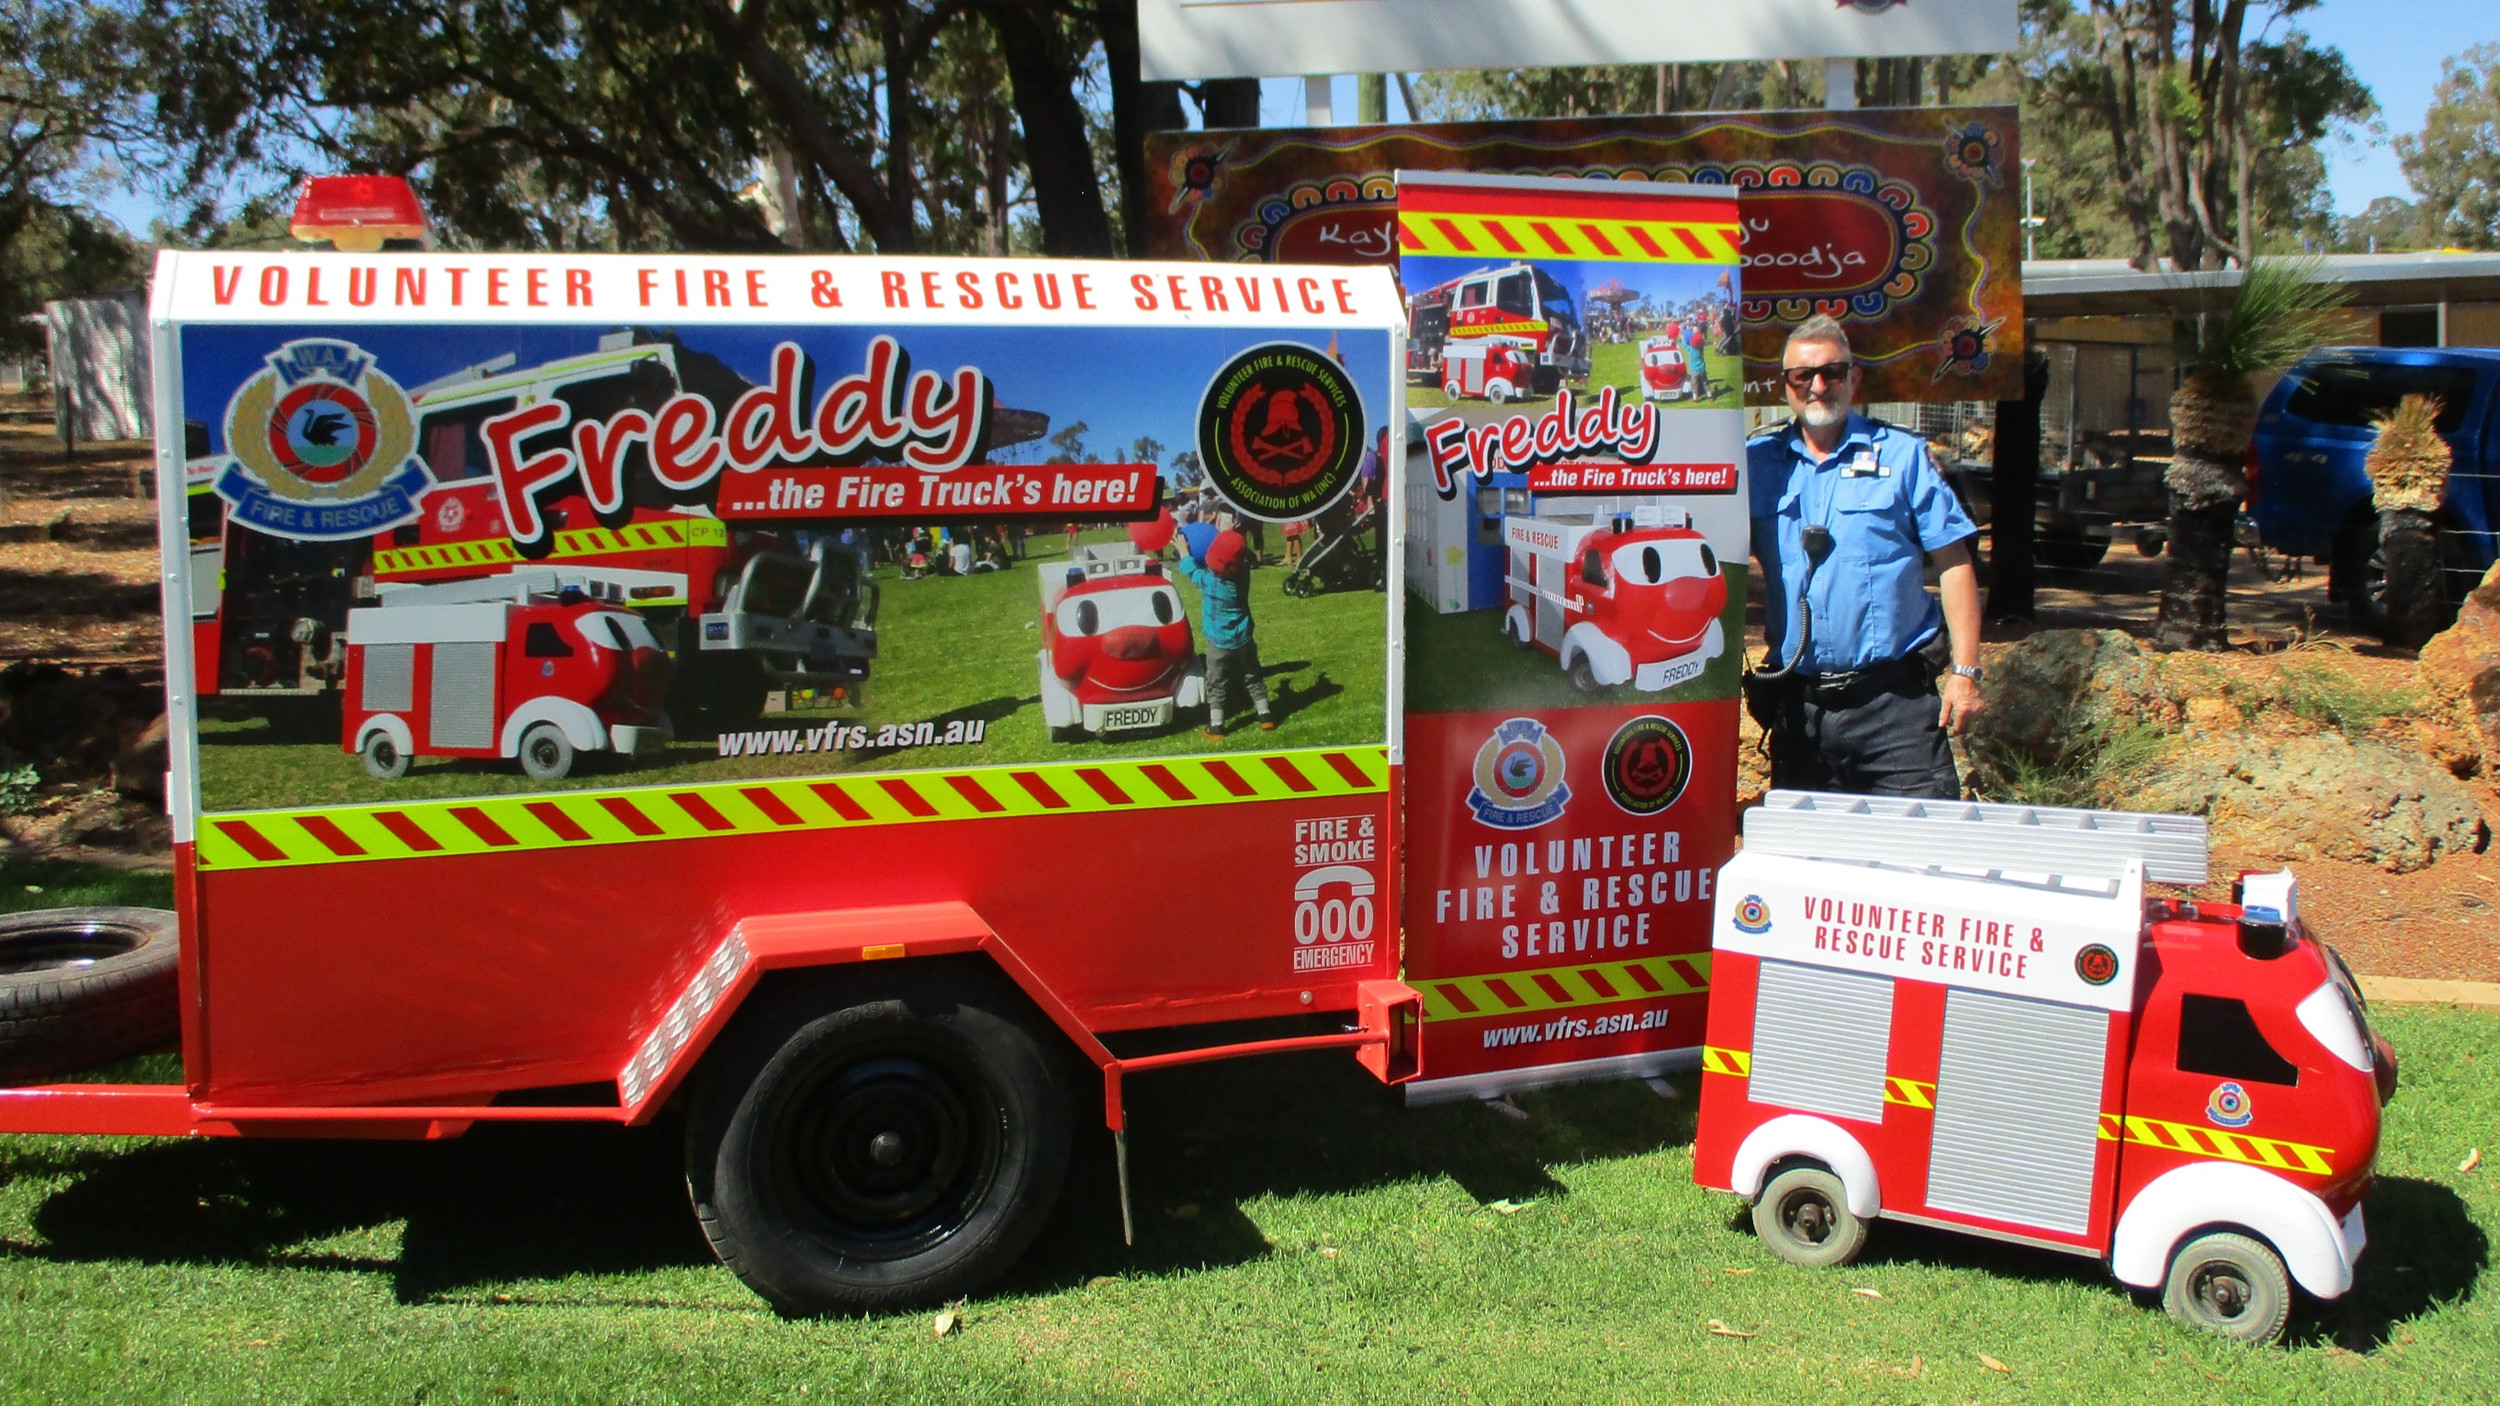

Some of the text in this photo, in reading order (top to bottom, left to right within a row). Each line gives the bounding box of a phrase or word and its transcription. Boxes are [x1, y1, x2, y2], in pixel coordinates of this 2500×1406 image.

[1319, 221, 1399, 256] Kay
[213, 264, 1359, 315] VOLUNTEER FIRE & RESCUE SERVICE
[1217, 355, 1347, 409] VOLUNTEER FIRE & RESCUE SERVICES
[483, 334, 985, 544] Freddy
[1424, 385, 1657, 492] Freddy
[733, 478, 824, 511] ...the
[837, 475, 906, 509] Fire
[1052, 472, 1140, 504] here!
[1231, 472, 1337, 509] ASSOCIATION OF WA (INC)
[1533, 469, 1578, 486] ...the
[1583, 468, 1616, 486] Fire
[1685, 467, 1728, 485] here!
[250, 497, 401, 528] FIRE & RESCUE
[1511, 528, 1559, 550] FIRE & RESCUE
[1662, 661, 1700, 684] FREDDY
[1105, 706, 1158, 728] FREDDY
[718, 719, 985, 757] www.vfrs.asn.au
[1295, 817, 1375, 843] FIRE &
[1483, 808, 1505, 821] FIRE
[1516, 803, 1556, 823] RESCUE
[1294, 839, 1375, 865] SMOKE
[1474, 831, 1680, 879] VOLUNTEER
[1436, 868, 1712, 923] FIRE & RESCUE
[1294, 897, 1374, 945] 000
[1502, 913, 1650, 959] SERVICE
[1804, 895, 1945, 938] VOLUNTEER
[1960, 917, 2015, 949] FIRE
[2030, 927, 2044, 952] &
[1293, 943, 1374, 970] EMERGENCY
[1815, 926, 2028, 980] RESCUE SERVICE
[1483, 1008, 1669, 1048] www.vfrs.asn.au
